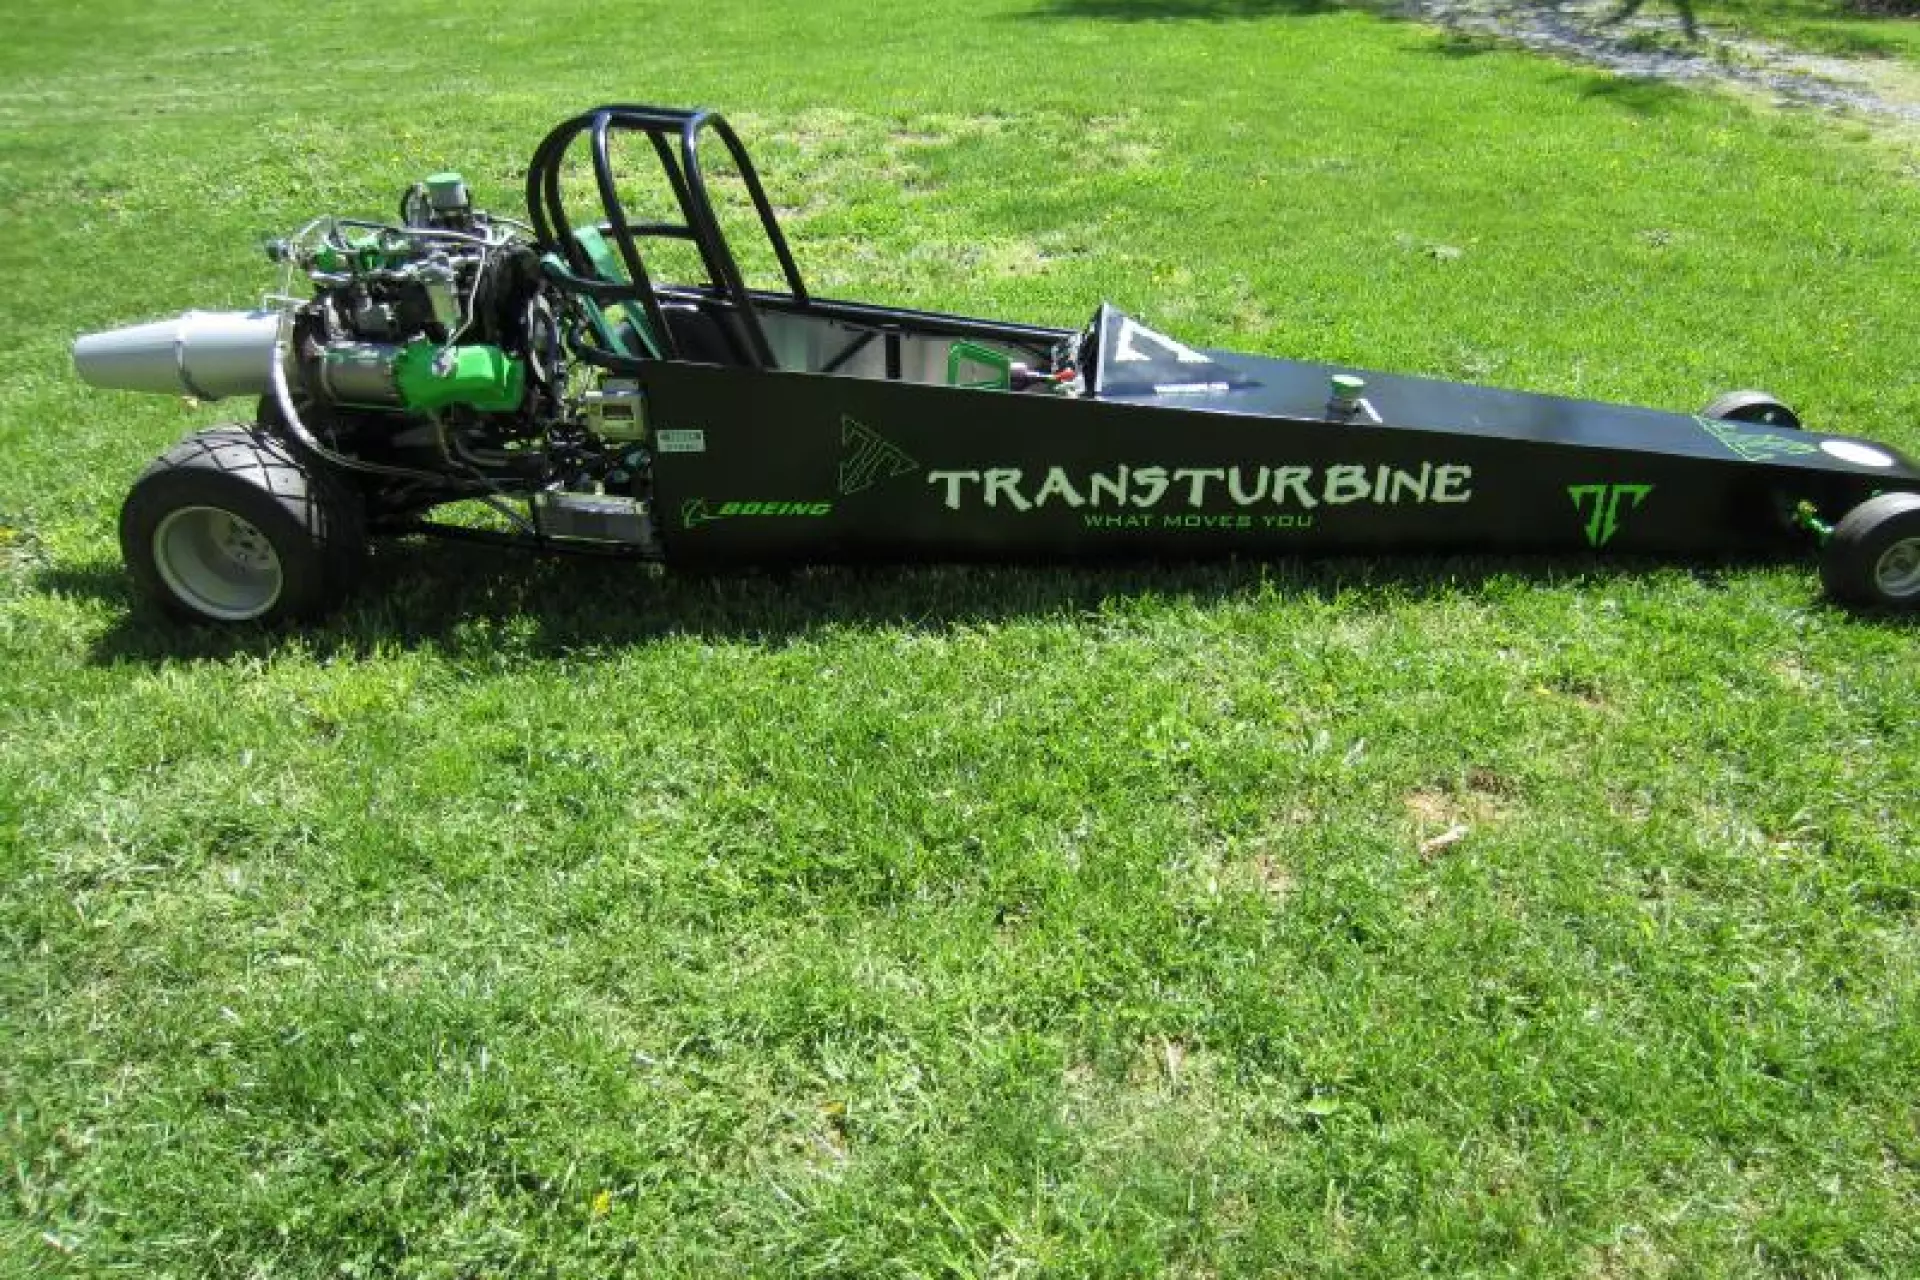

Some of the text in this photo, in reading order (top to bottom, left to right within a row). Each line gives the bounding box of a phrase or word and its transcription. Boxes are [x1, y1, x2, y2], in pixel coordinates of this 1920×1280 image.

[928, 462, 1472, 510] TRANSTURBINE
[720, 501, 832, 515] BOEING
[1085, 513, 1312, 527] WHAT MOVES YOU
